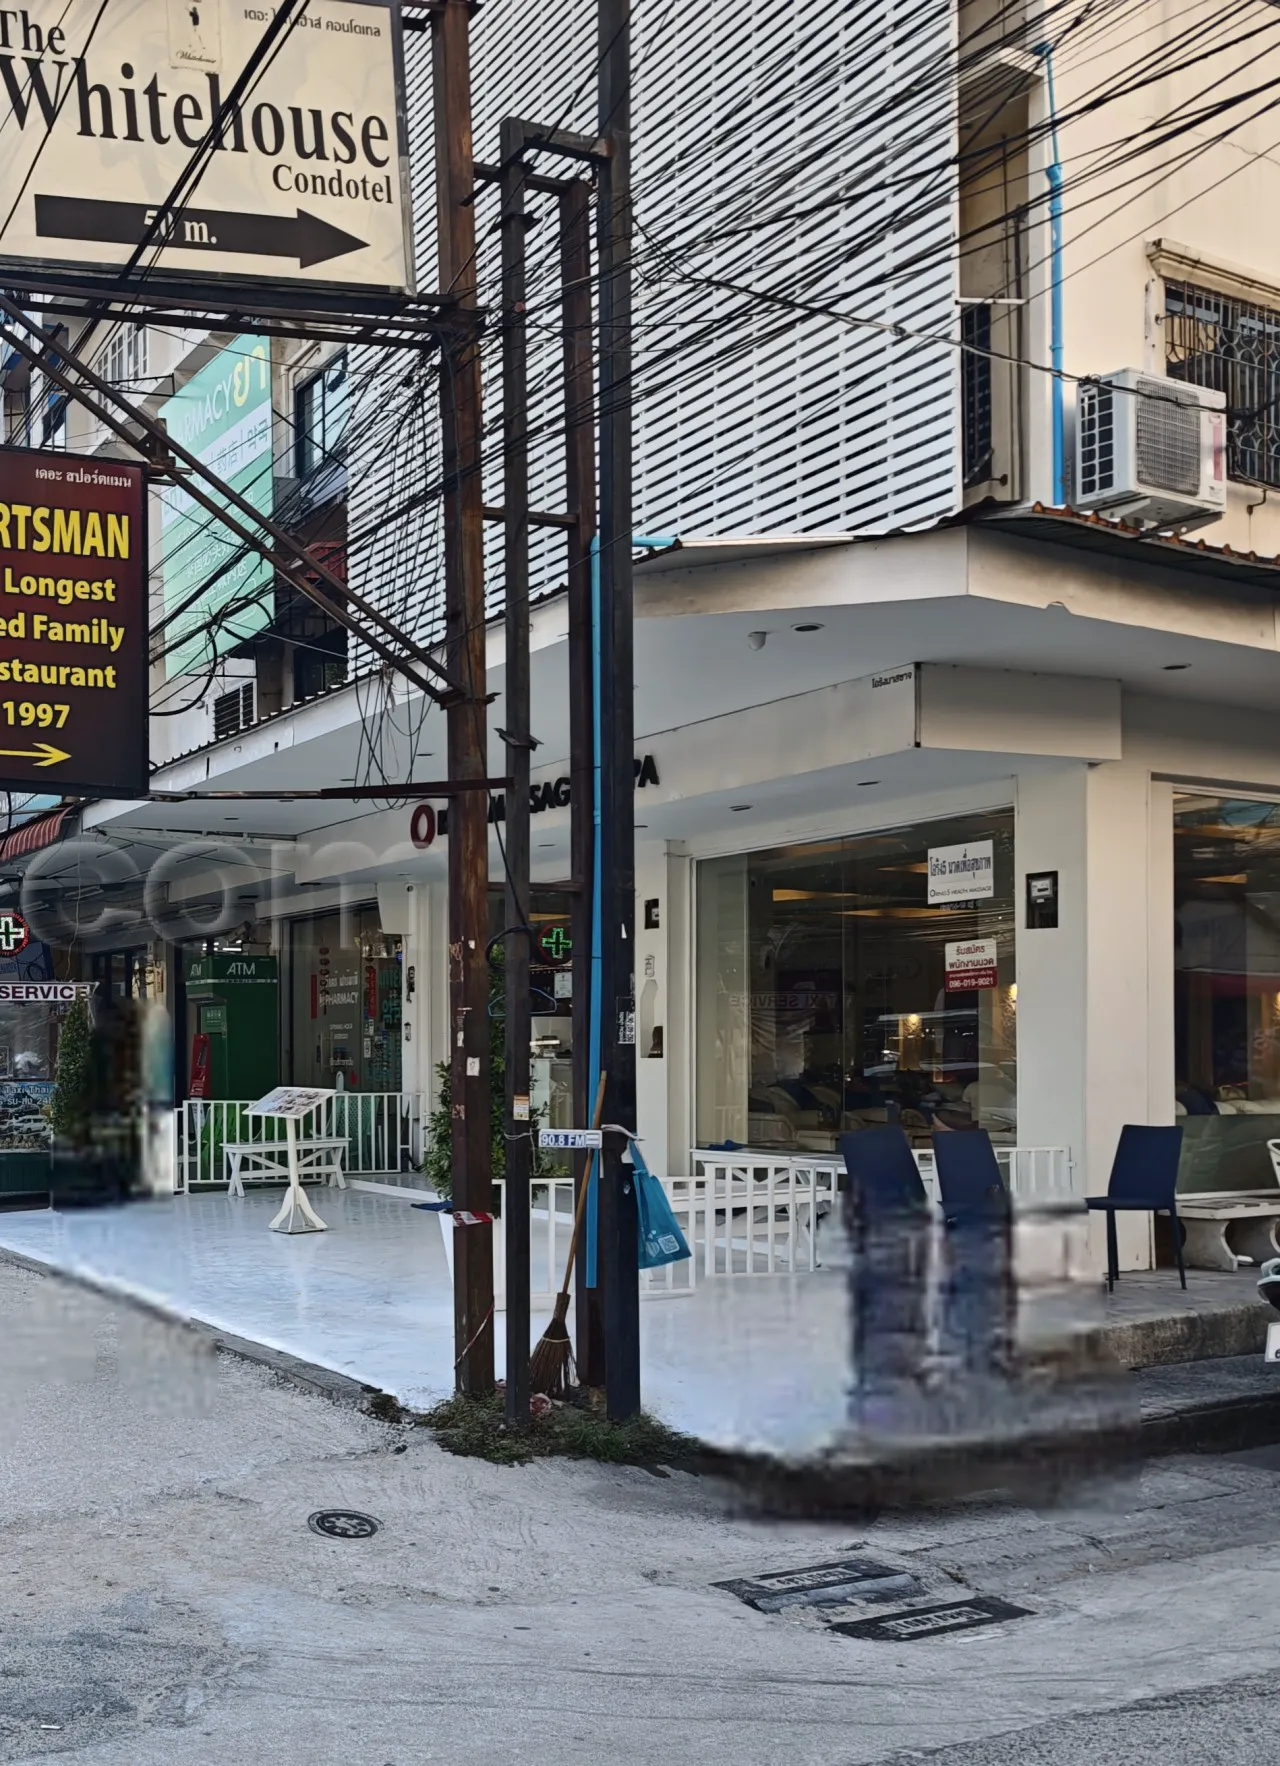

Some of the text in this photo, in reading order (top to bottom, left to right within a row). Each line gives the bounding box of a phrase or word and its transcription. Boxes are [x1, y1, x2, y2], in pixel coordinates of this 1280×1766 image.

[272, 163, 394, 204] Condotel
[183, 219, 218, 245] m.
[233, 344, 267, 408] ยา
[35, 467, 63, 482] เดอะ
[4, 567, 116, 605] Longest
[32, 613, 125, 652] Family
[1, 701, 70, 729] 1997
[227, 962, 256, 976] ATM
[541, 1134, 585, 1147] 90.8 FM
